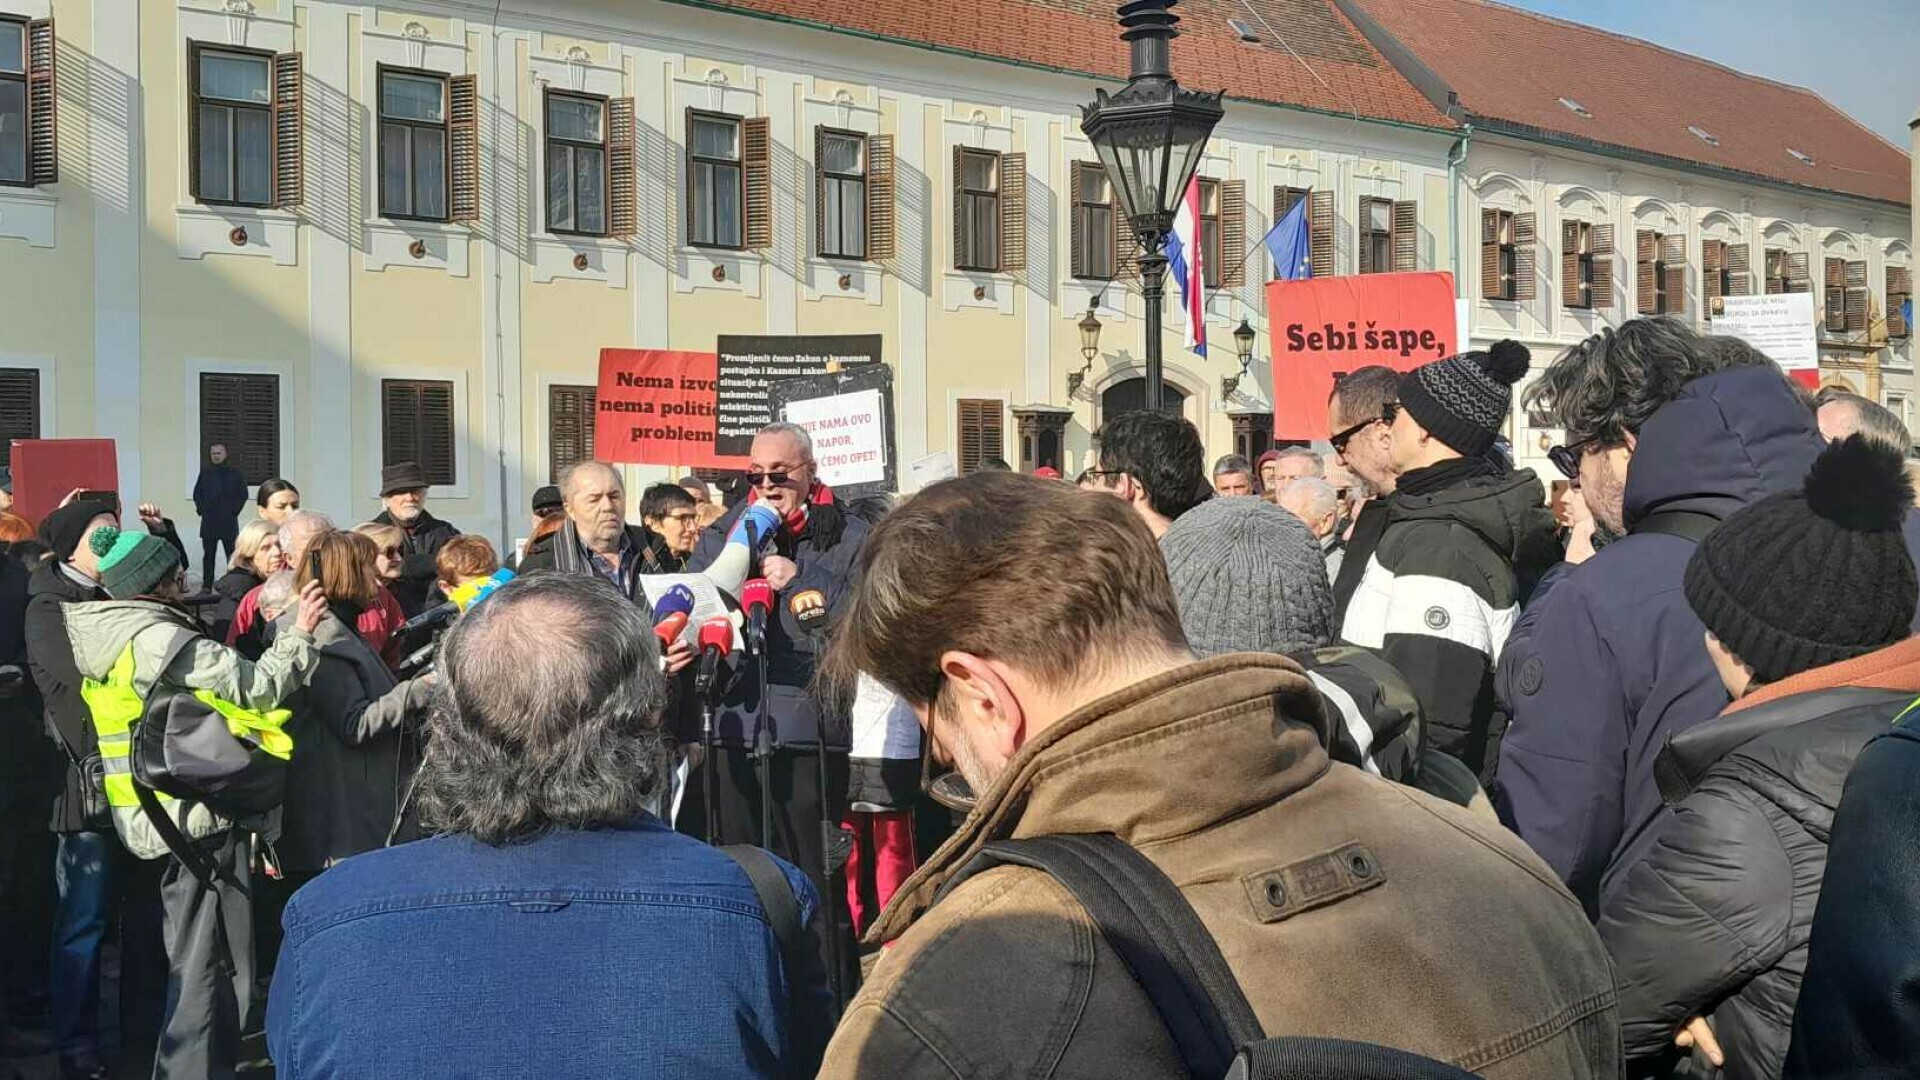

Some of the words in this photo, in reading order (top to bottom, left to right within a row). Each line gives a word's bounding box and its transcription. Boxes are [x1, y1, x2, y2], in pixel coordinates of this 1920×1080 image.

[1286, 321, 1358, 351] Sebi
[1364, 320, 1446, 357] šape,
[795, 354, 821, 362] Zakon
[720, 366, 760, 376] postupku
[761, 366, 766, 375] i
[766, 366, 801, 375] Kazneni
[616, 371, 674, 389] Nema
[680, 374, 717, 391] izvo
[600, 400, 654, 414] nema
[819, 416, 849, 429] NAMA
[850, 413, 872, 426] OVO
[817, 435, 854, 448] NAPOR,
